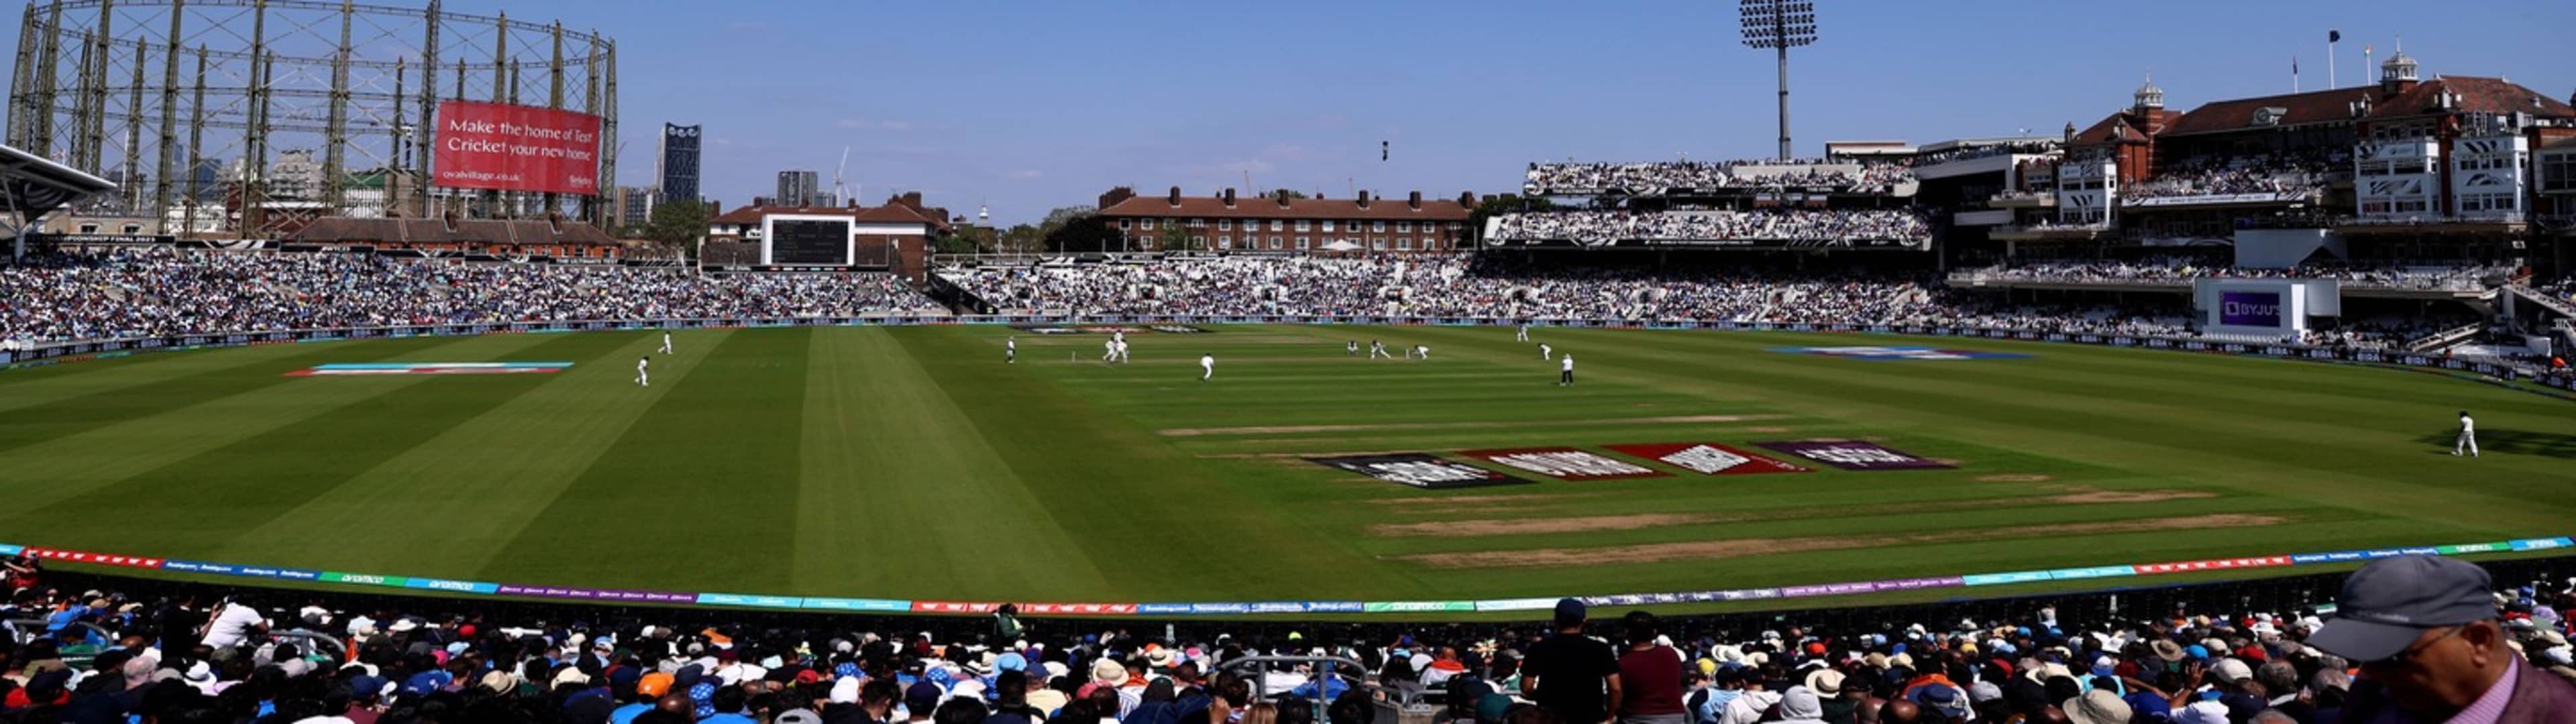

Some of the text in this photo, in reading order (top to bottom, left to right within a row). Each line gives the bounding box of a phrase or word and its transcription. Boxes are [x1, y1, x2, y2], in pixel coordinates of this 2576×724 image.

[450, 119, 592, 143] Make the home of Test
[448, 137, 591, 161] Cricket your new home
[443, 171, 520, 181] ovalvillage.co.uk
[2241, 304, 2281, 316] BYJU'S
